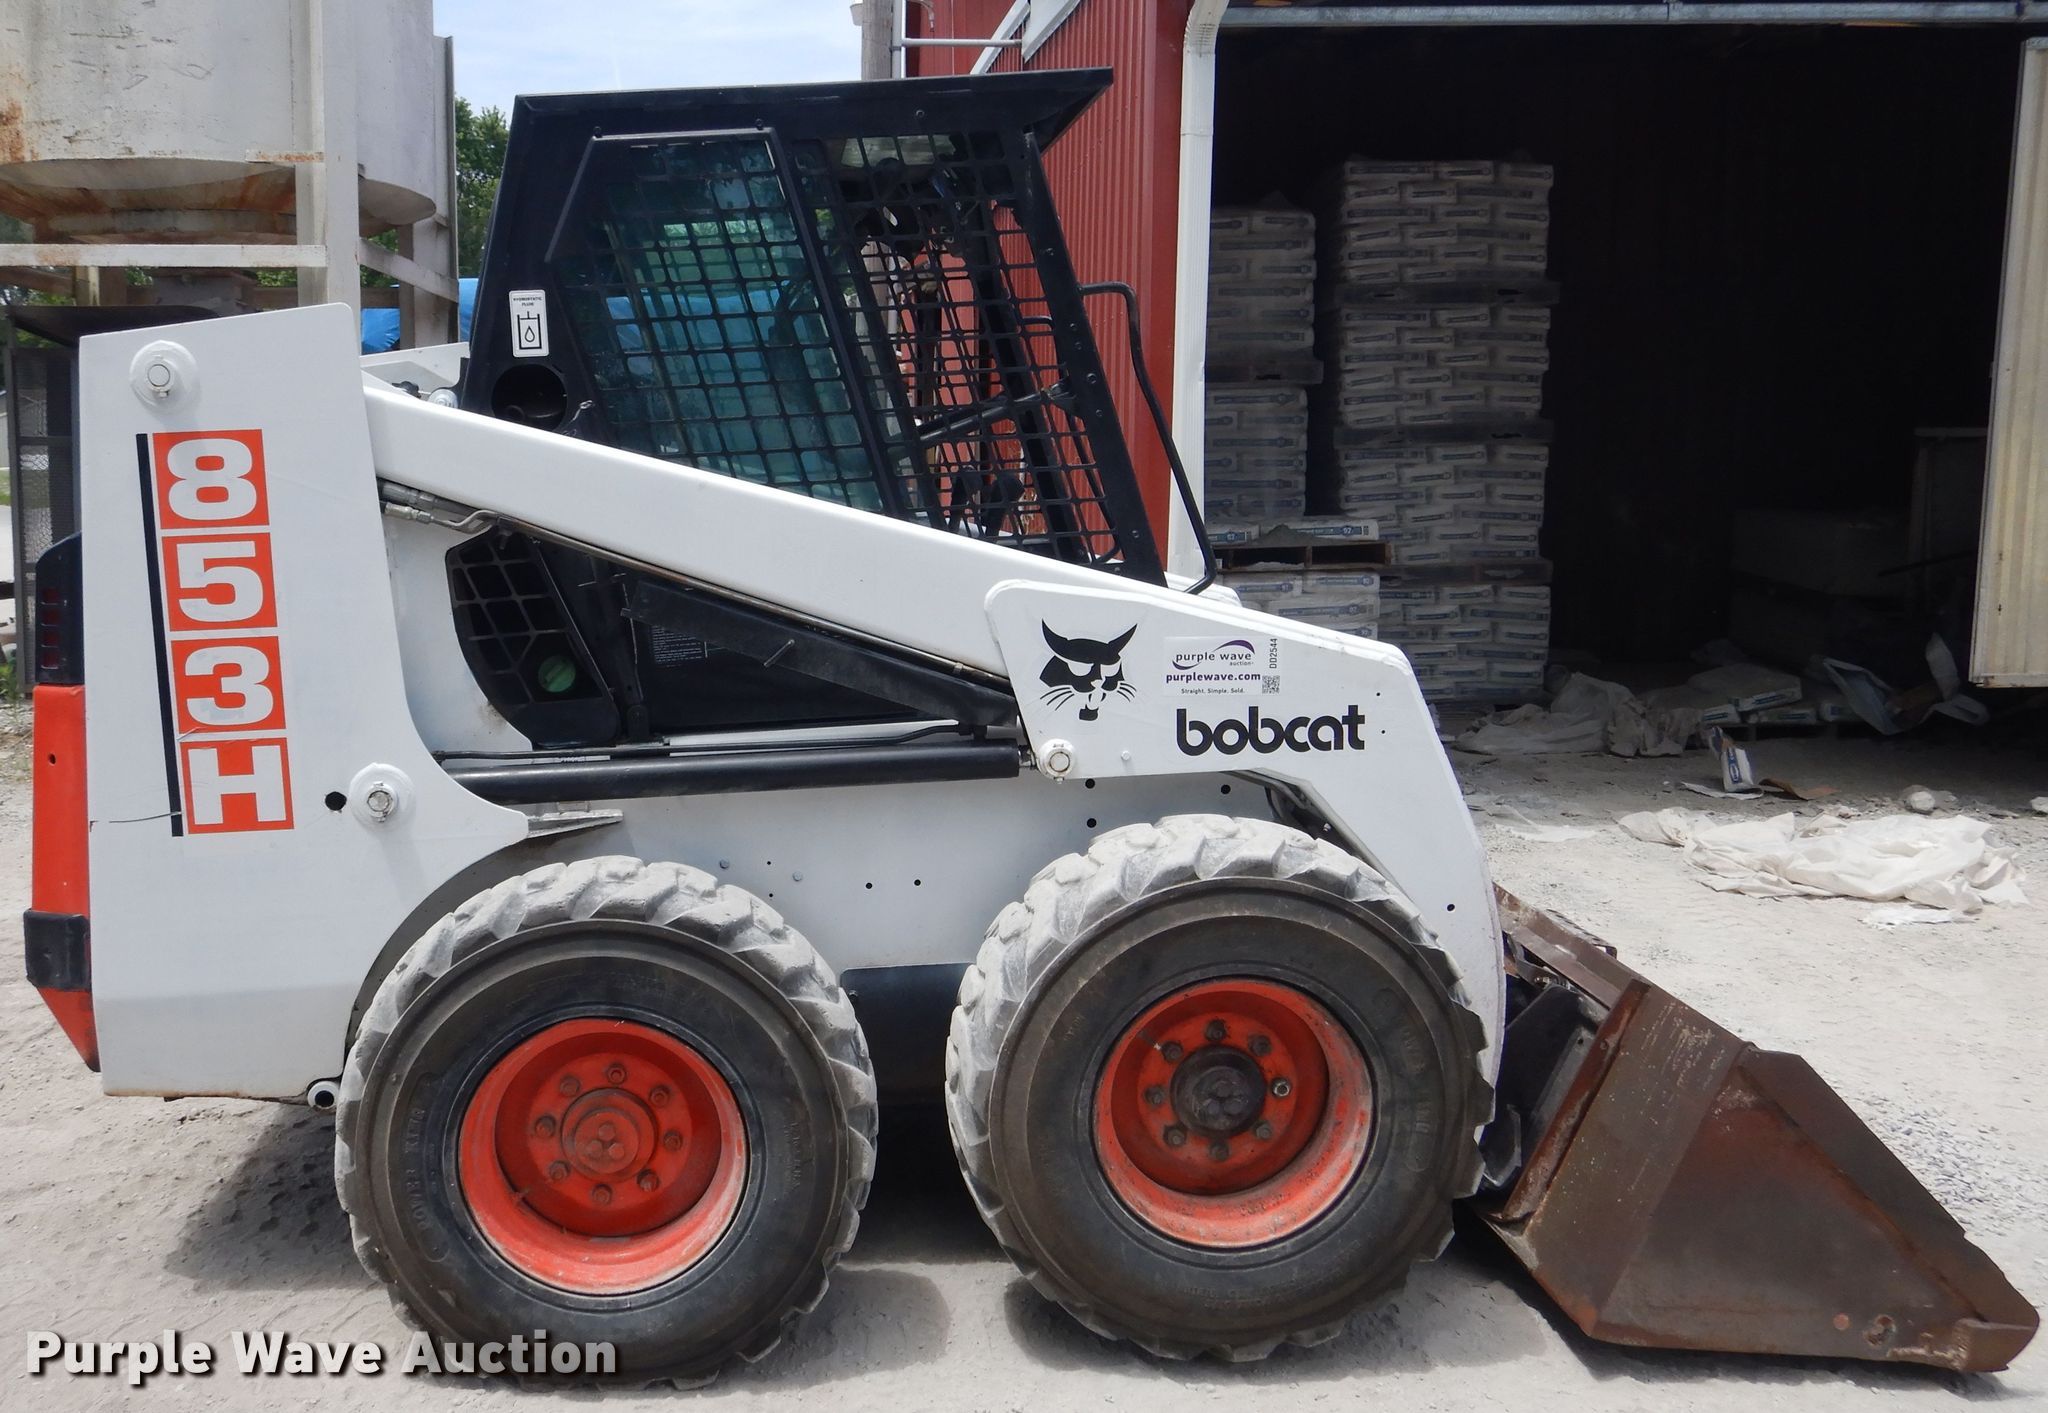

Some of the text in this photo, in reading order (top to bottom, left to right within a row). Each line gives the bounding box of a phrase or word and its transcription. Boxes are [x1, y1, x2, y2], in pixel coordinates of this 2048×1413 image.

[167, 438, 287, 826] 853H
[1176, 652, 1252, 663] purple wave
[1269, 638, 1278, 669] DD2544
[1166, 672, 1261, 684] purplewave.com
[1176, 705, 1366, 757] bobcat
